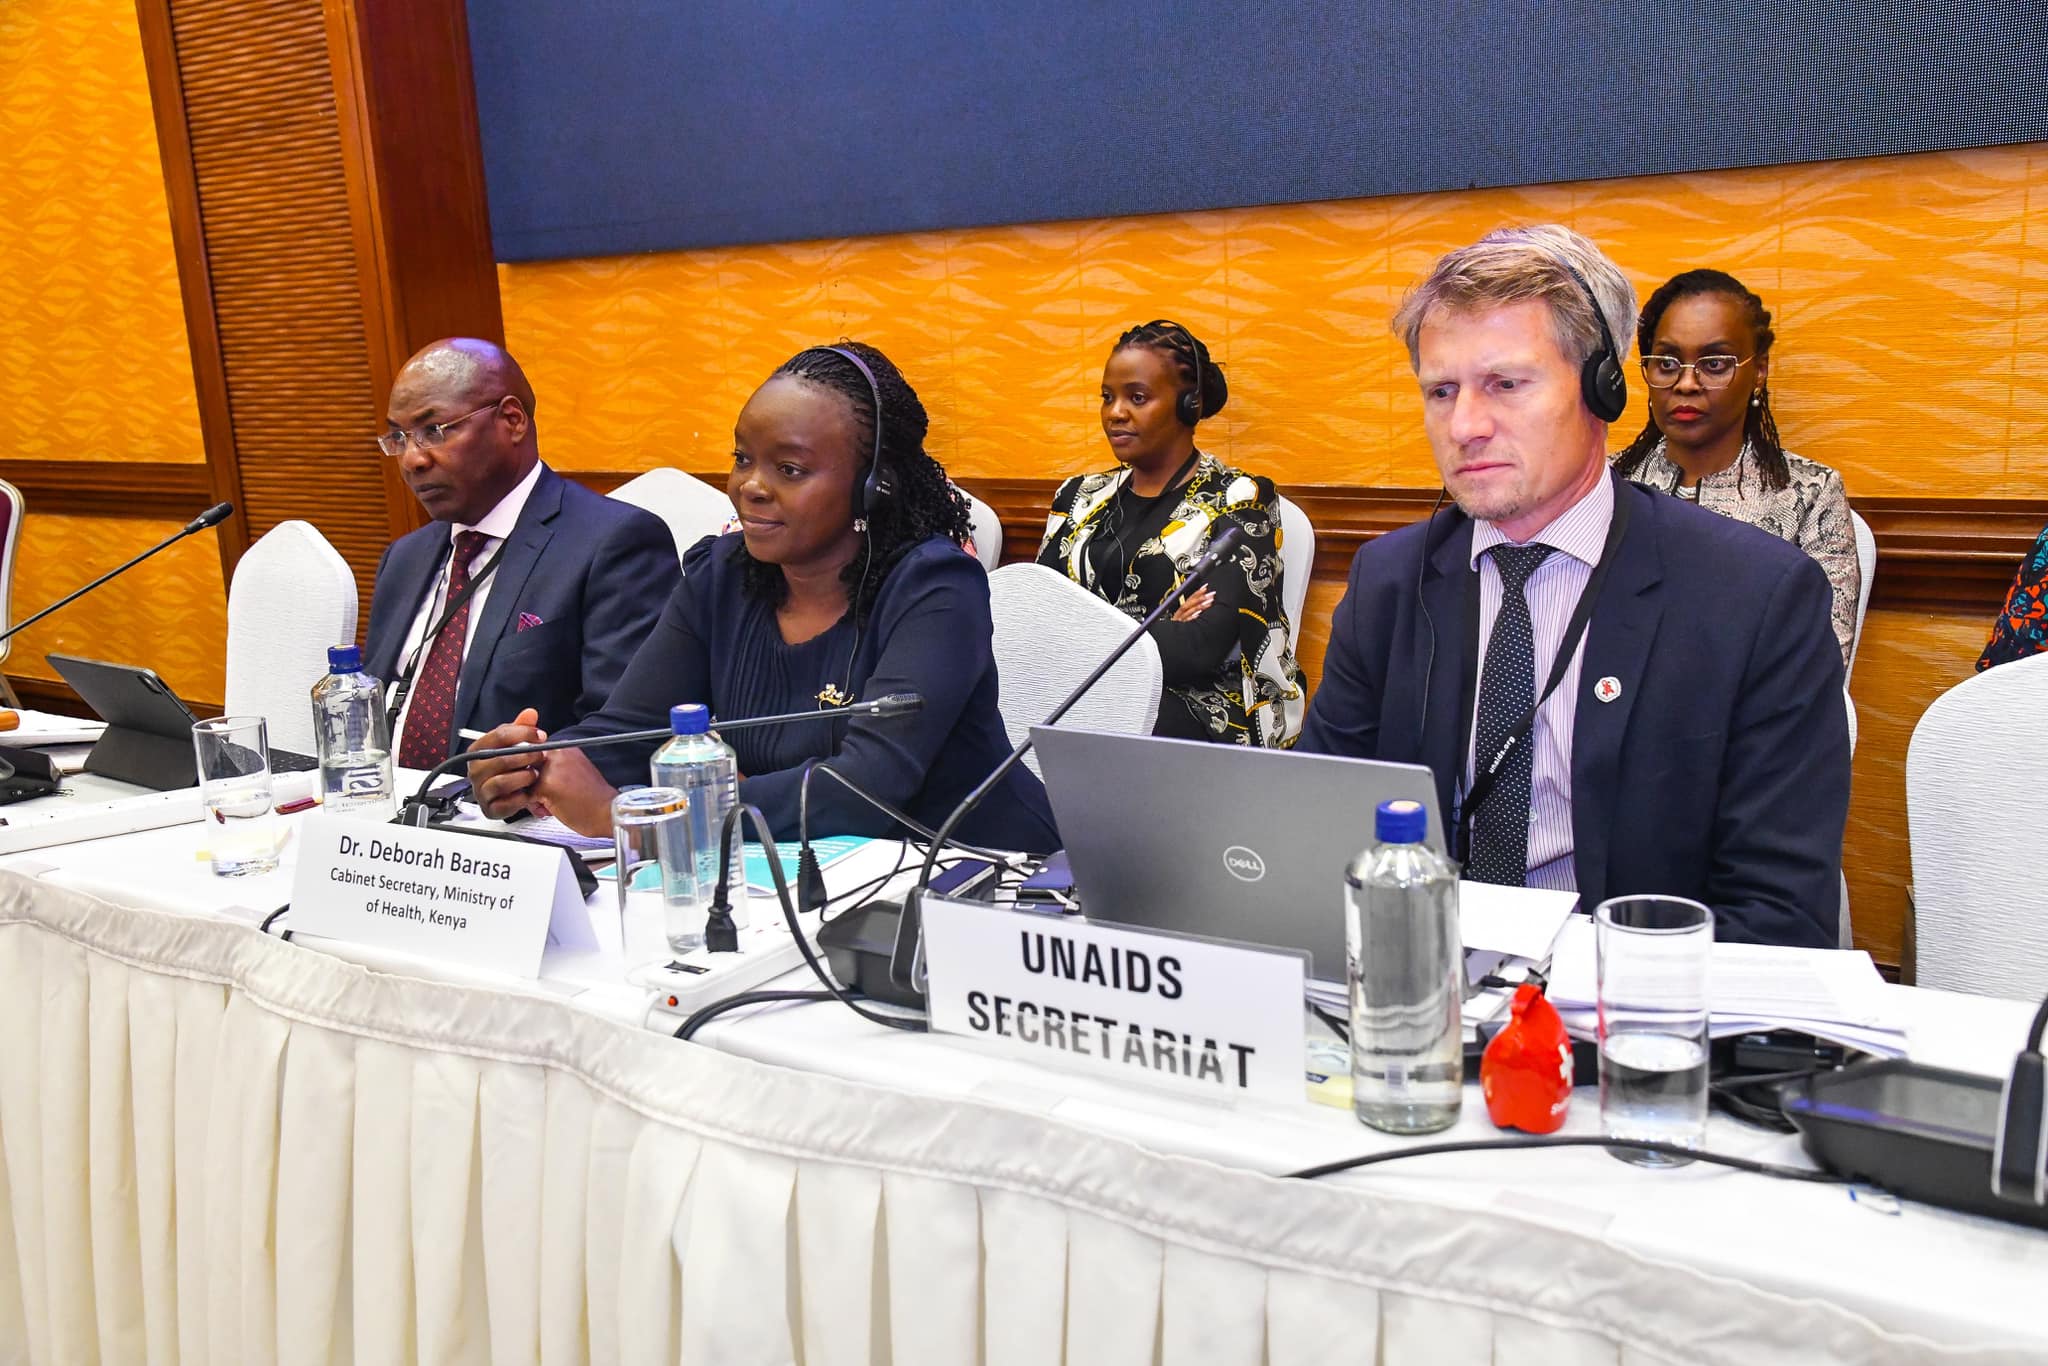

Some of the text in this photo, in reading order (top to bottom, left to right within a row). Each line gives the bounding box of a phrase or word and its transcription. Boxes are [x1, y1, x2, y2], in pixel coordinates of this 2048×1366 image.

[1488, 735, 1516, 774] unaids.org
[338, 835, 511, 880] Dr. Deborah Barasa
[1227, 856, 1261, 871] DELL
[330, 867, 515, 910] Cabinet Secretary, Ministry of
[366, 898, 467, 931] of Health, Kenya
[1020, 930, 1184, 1001] UNAIDS
[966, 990, 1257, 1089] SECRETARIAT
